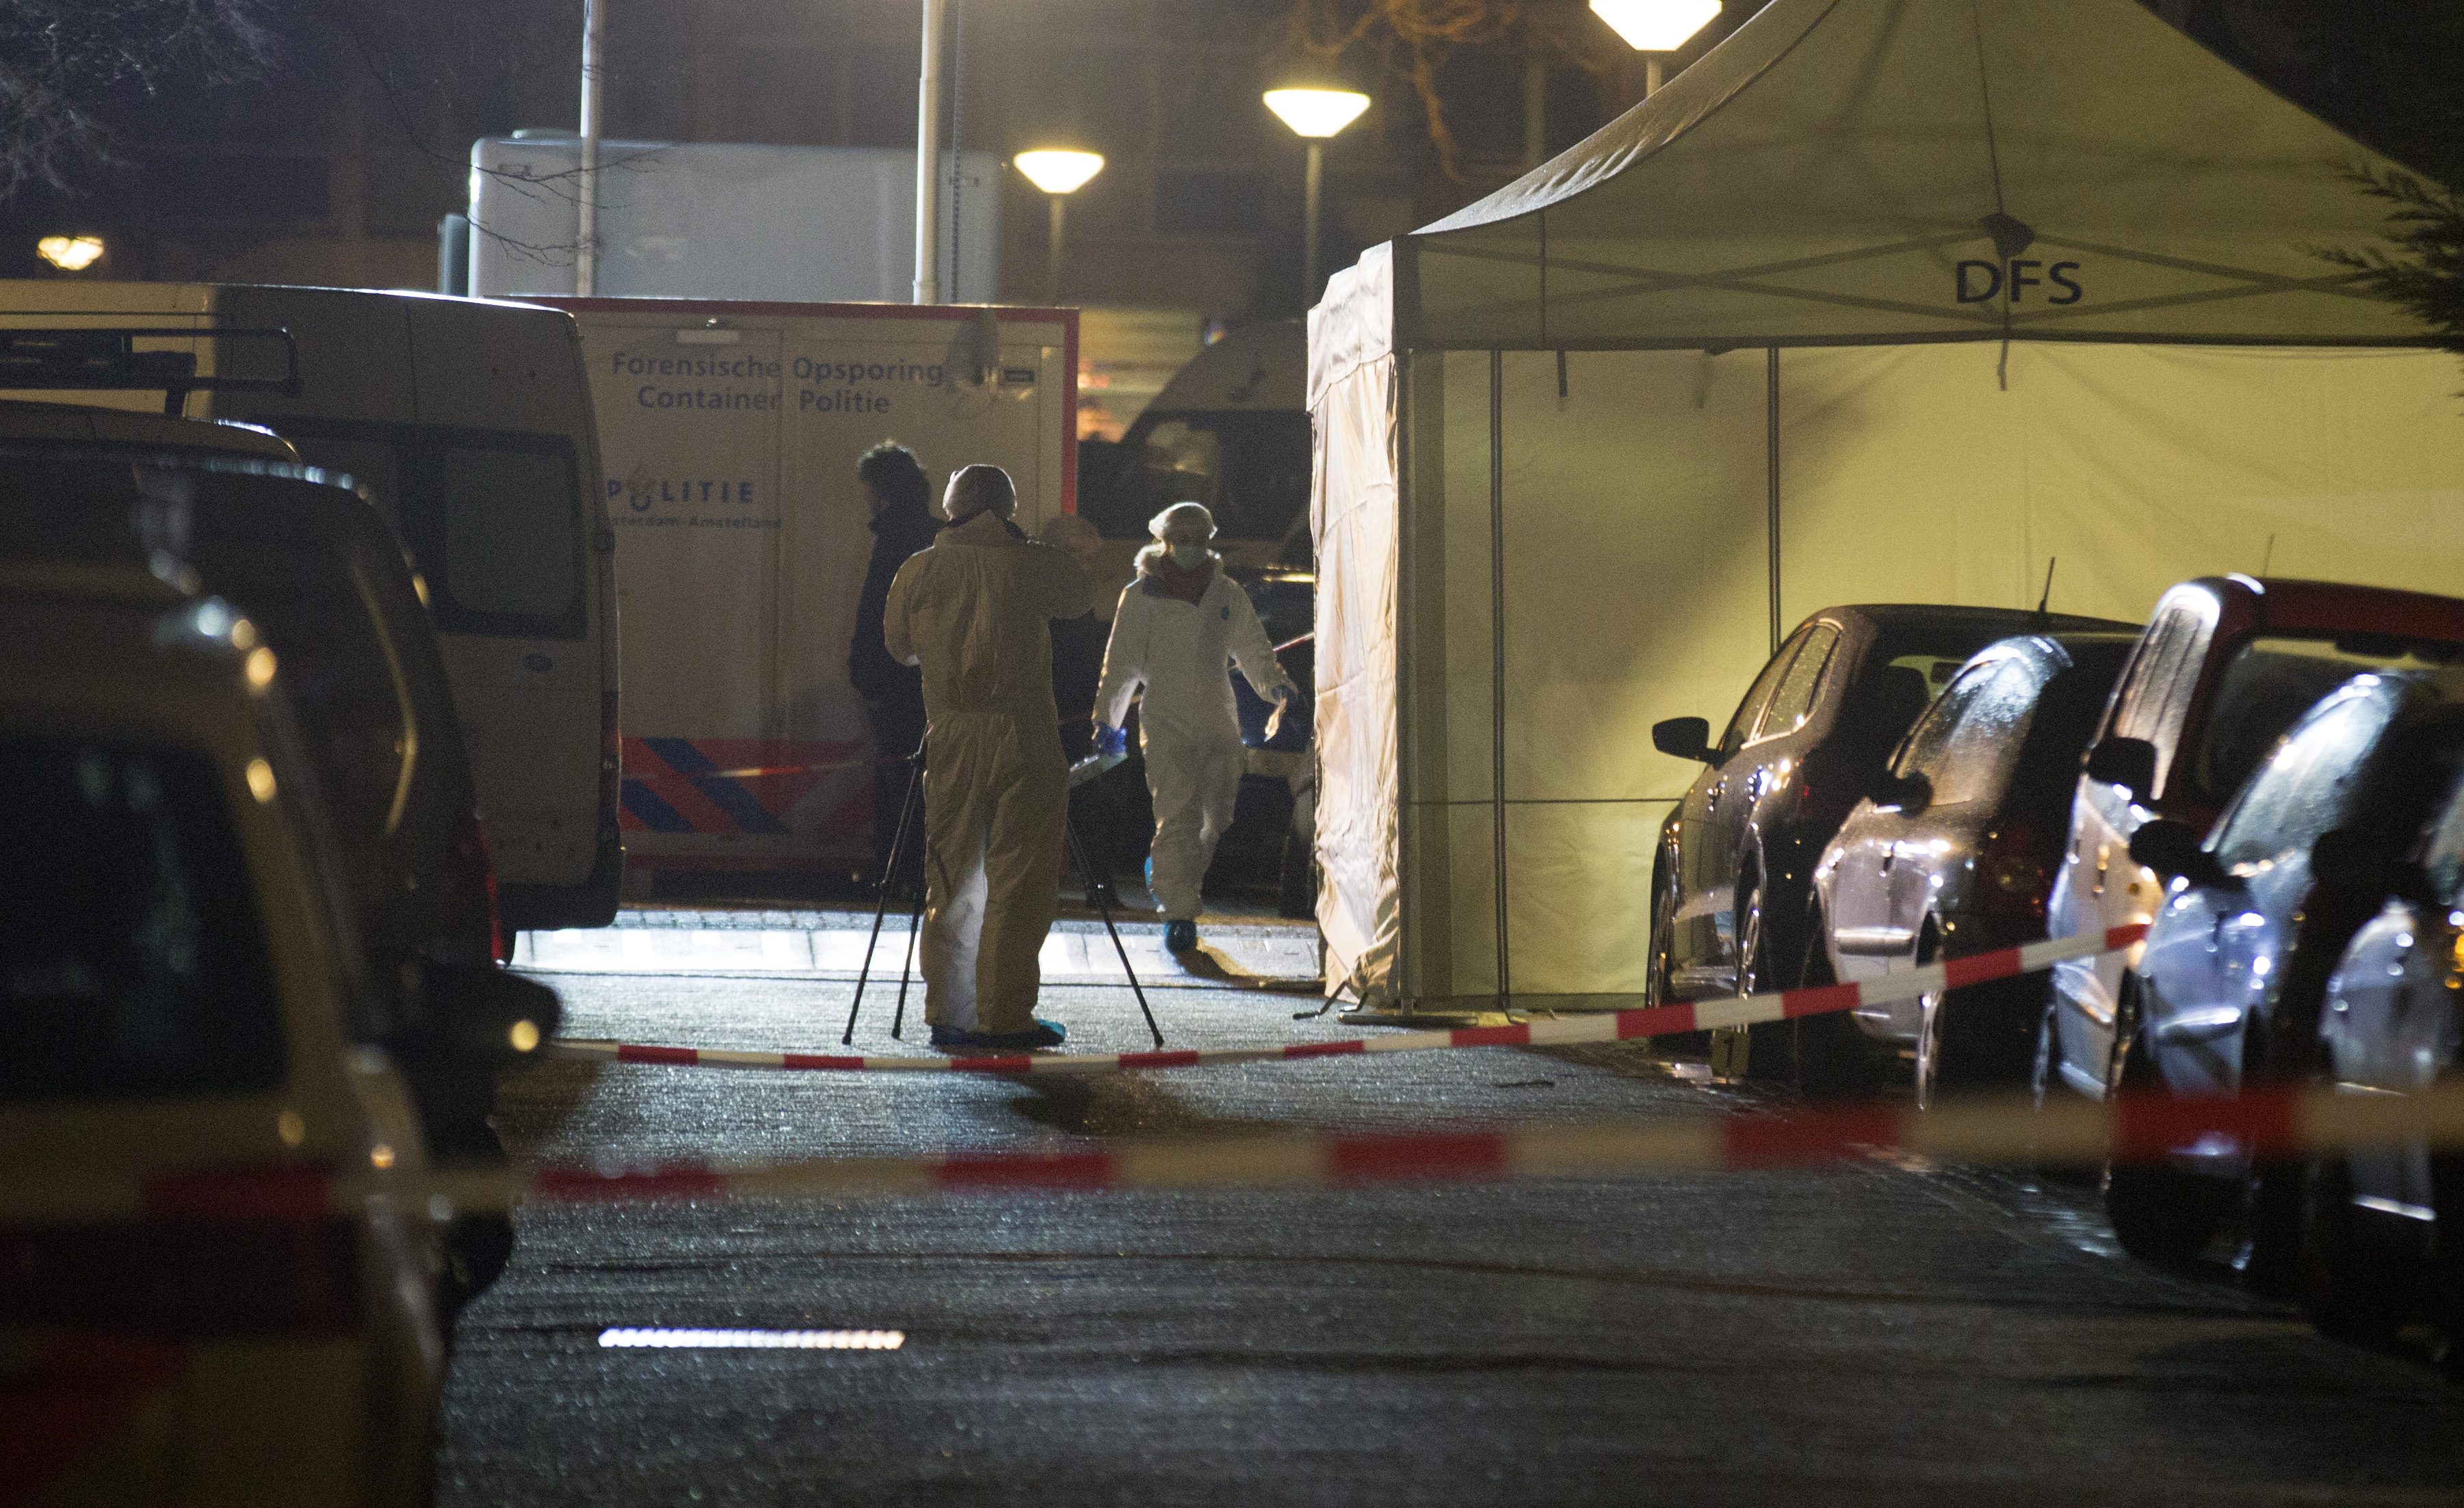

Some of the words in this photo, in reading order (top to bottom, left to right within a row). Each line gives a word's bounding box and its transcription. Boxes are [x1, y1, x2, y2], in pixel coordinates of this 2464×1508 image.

[1956, 260, 2082, 304] DFS
[613, 352, 780, 376] Forensische
[793, 358, 943, 387] Opsporing
[638, 386, 779, 410] Container
[800, 390, 890, 413] Politie
